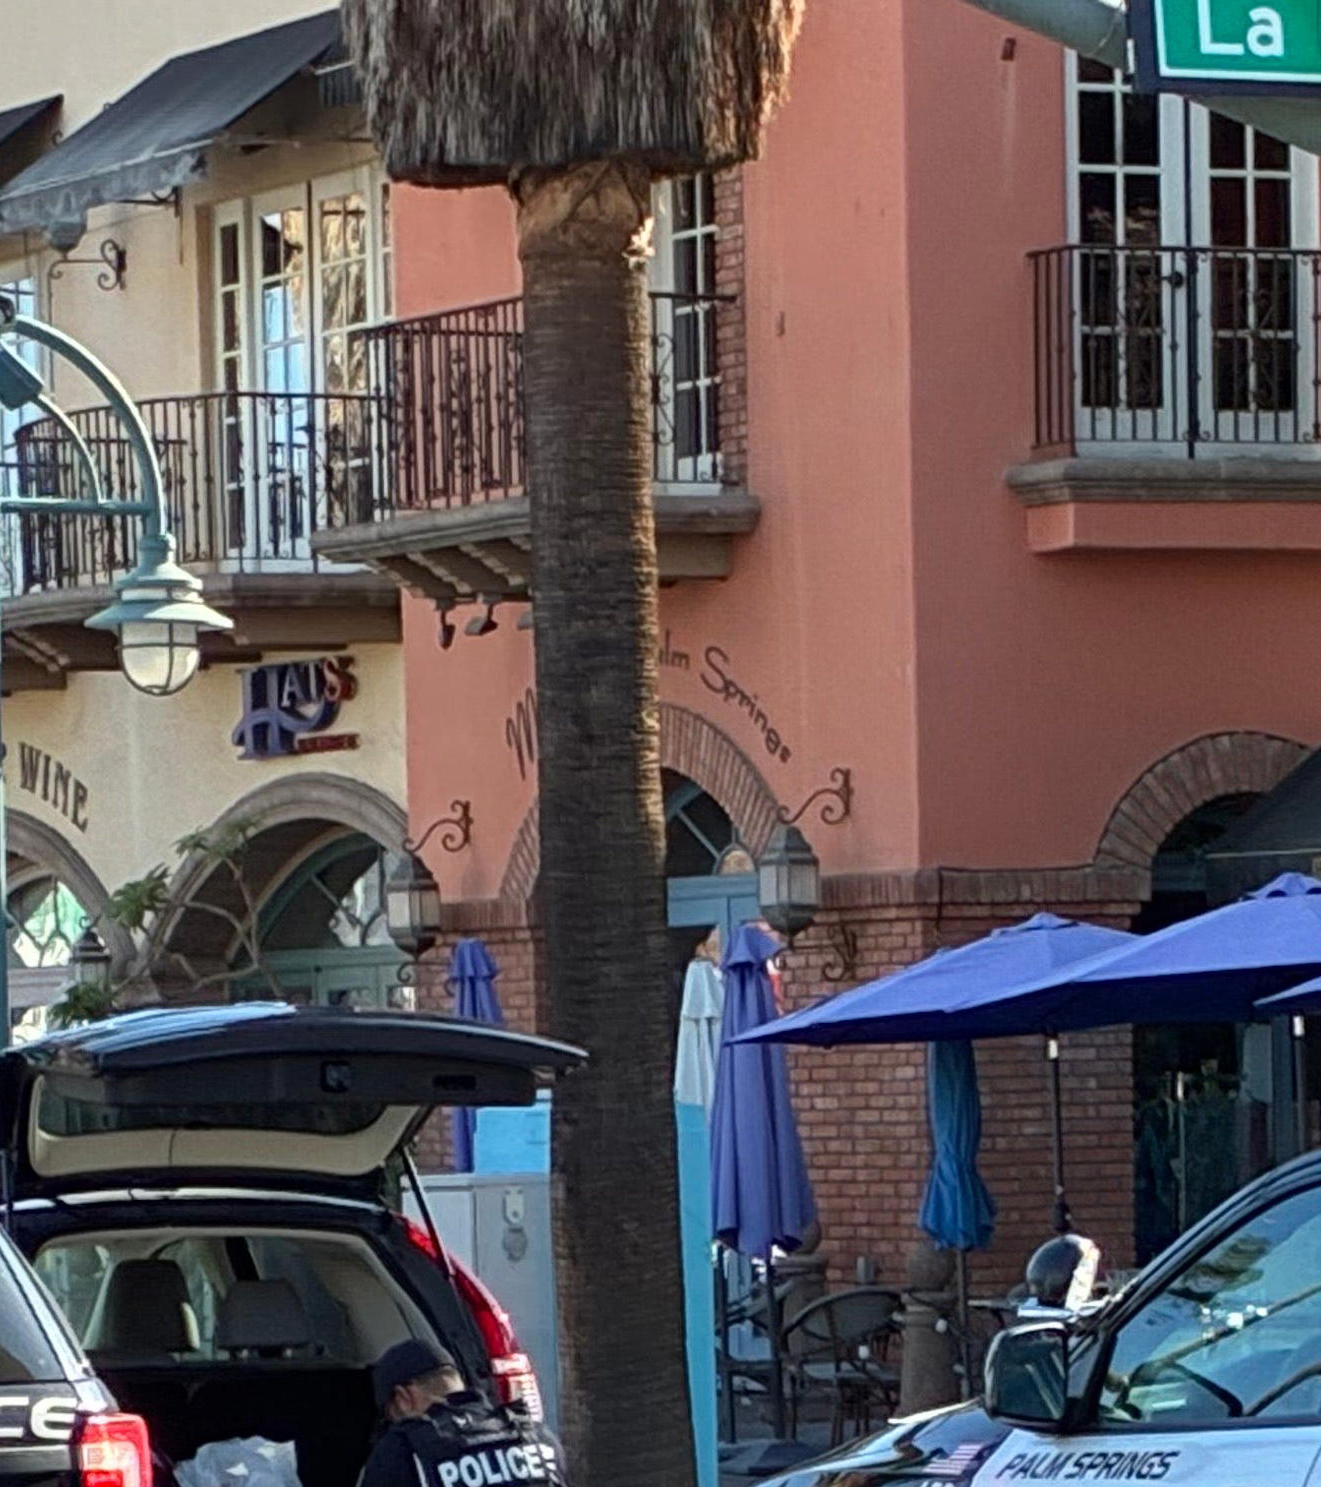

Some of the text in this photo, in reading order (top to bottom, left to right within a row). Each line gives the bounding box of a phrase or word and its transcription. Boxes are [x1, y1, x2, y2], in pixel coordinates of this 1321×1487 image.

[1197, 0, 1284, 57] La
[700, 646, 792, 763] Springs
[18, 741, 89, 833] WINE
[995, 1450, 1181, 1480] PALM SPRINGS
